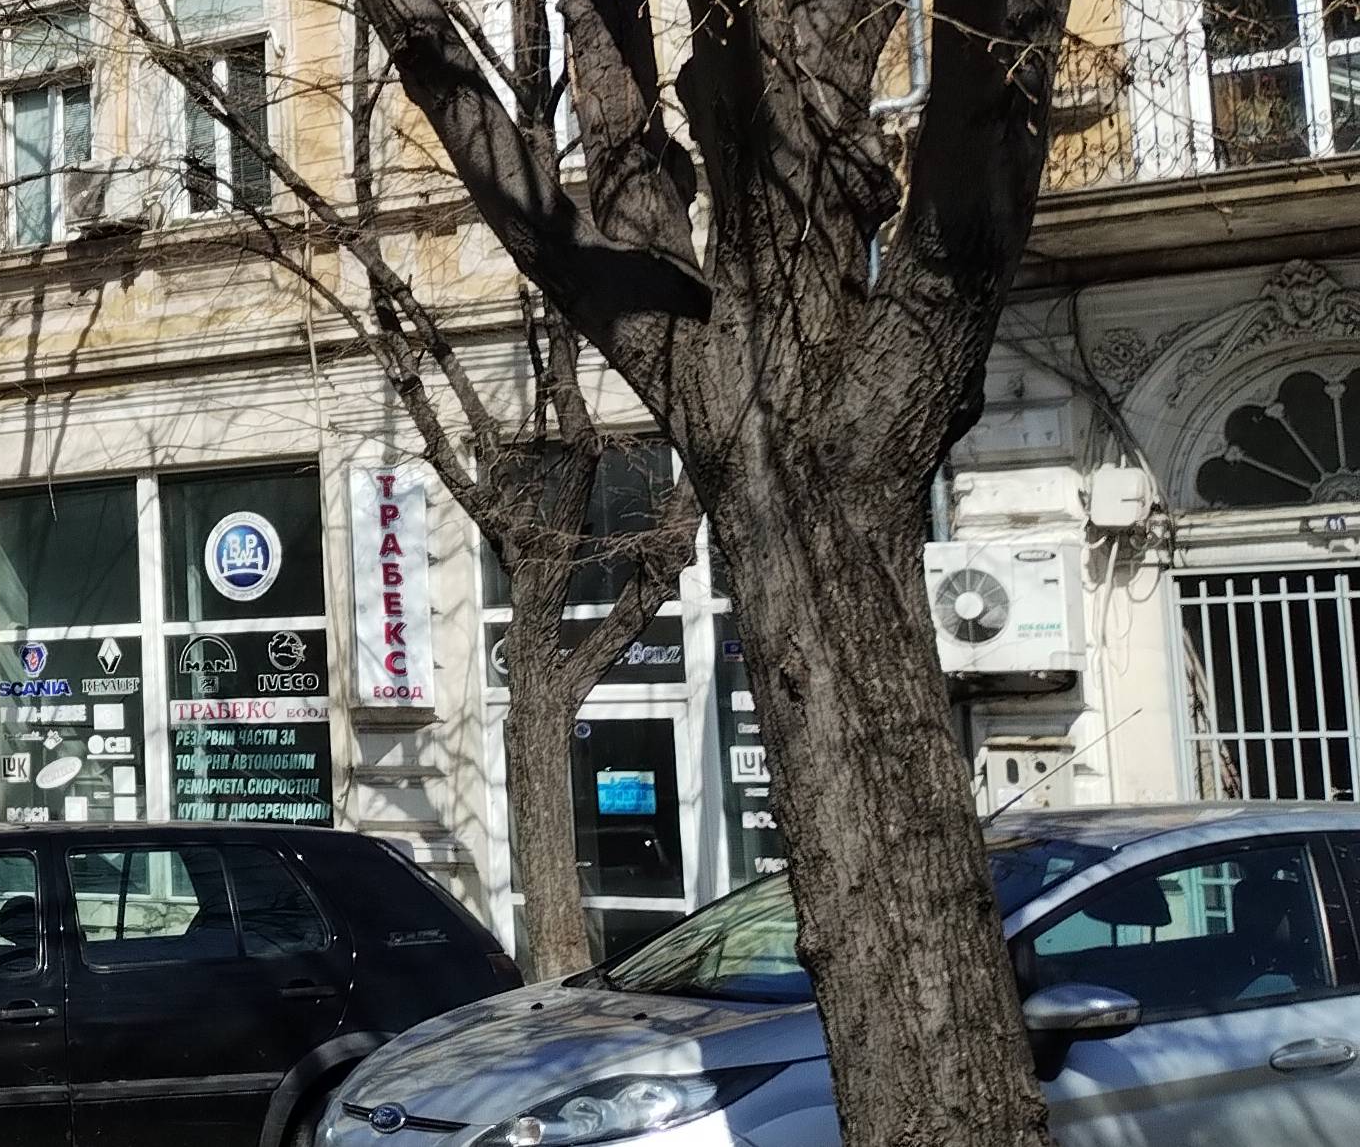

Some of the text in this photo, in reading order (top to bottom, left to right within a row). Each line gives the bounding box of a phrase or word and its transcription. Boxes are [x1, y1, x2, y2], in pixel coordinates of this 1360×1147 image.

[376, 475, 408, 677] ТРАБЕКС
[185, 661, 231, 673] MAN
[258, 673, 319, 692] IVECO
[175, 702, 276, 721] ТРАБЕКС
[239, 730, 278, 745] ЧАСТИ
[280, 730, 296, 745] ЗА
[176, 753, 316, 770] ТОВРНИ АВТОМОБИЛИ
[229, 803, 330, 823] ДИФЕРЕНЦИАЛИ
